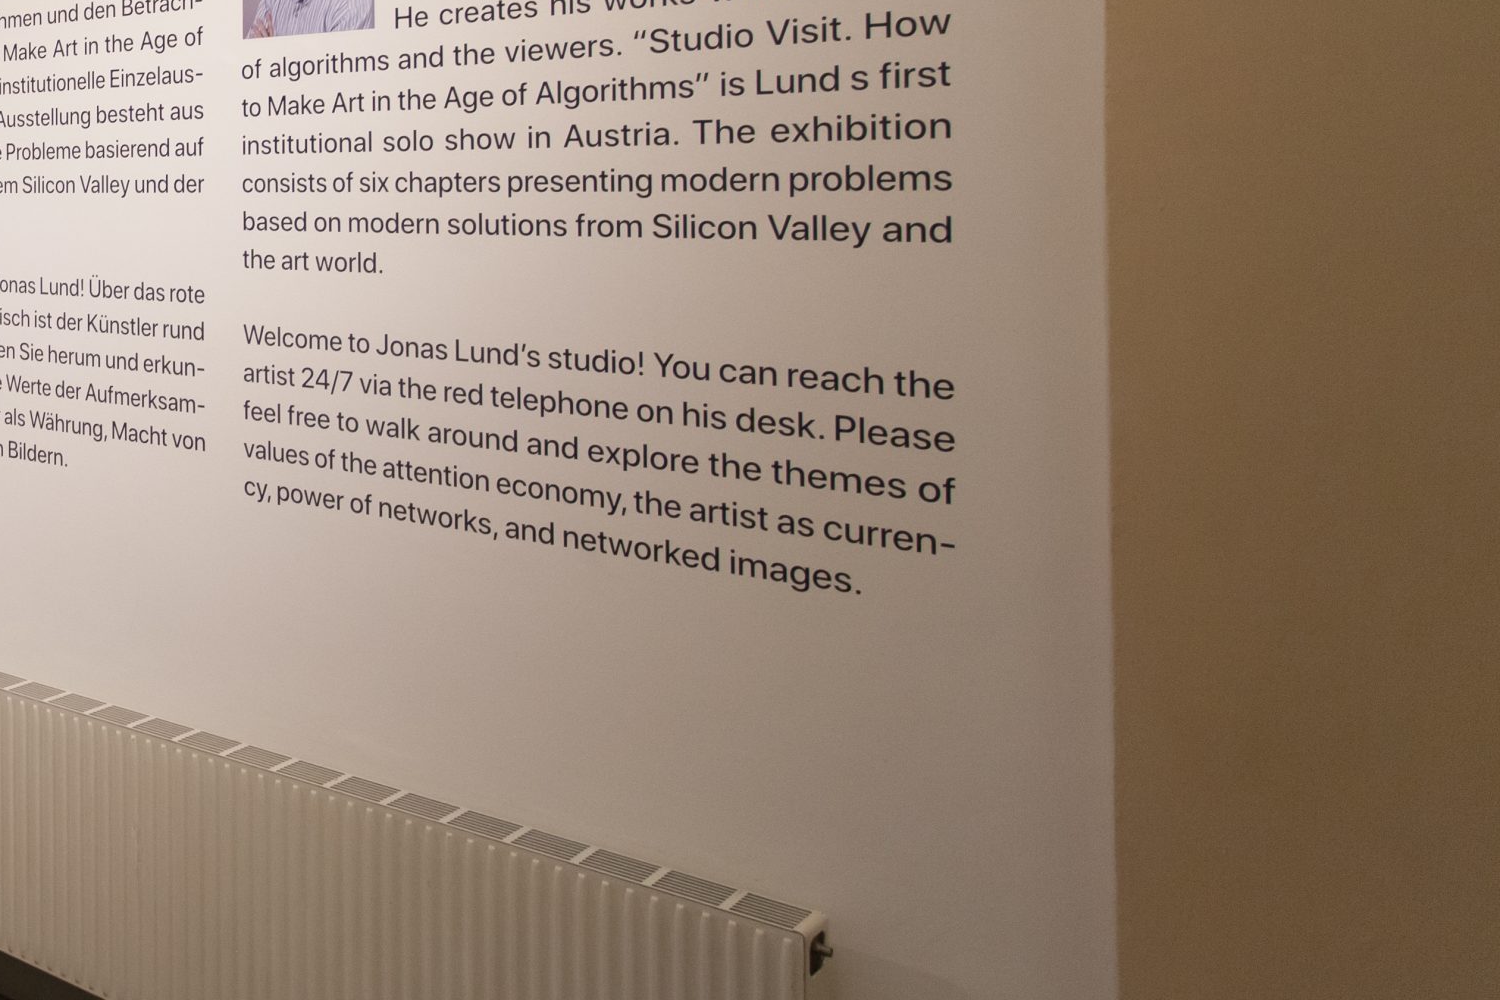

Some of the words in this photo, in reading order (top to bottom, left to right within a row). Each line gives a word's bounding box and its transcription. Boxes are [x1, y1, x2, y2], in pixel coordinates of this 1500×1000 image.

[46, 2, 79, 25] und
[83, 0, 117, 22] den
[394, 5, 429, 30] He
[438, 0, 539, 26] creates
[241, 57, 263, 81] of
[268, 51, 390, 83] algorithms
[397, 44, 444, 71] and
[452, 42, 496, 67] the
[504, 38, 623, 64] viewers.
[765, 15, 852, 46] Visit.
[864, 10, 952, 40] How
[109, 65, 204, 89] Einzelaus-
[95, 101, 165, 125] besteht
[169, 104, 205, 122] aus
[5, 141, 82, 162] Probleme
[84, 136, 171, 160] basierend
[174, 135, 205, 158] auf
[241, 130, 373, 156] institutional
[382, 128, 435, 153] solo
[444, 127, 517, 152] show
[527, 124, 552, 150] in
[563, 120, 680, 149] Austria.
[691, 118, 756, 146] The
[770, 111, 952, 144] exhibition
[242, 210, 308, 233] based
[313, 215, 342, 233] on
[347, 211, 440, 235] modern
[447, 211, 568, 238] solutions
[574, 212, 643, 239] from
[651, 212, 758, 241] Silicon
[766, 213, 873, 250] Valley
[881, 214, 953, 244] and
[33, 309, 53, 330] ist
[55, 311, 84, 332] der
[86, 312, 160, 338] Künstler
[162, 320, 205, 342] rund
[243, 363, 296, 388] artist
[300, 366, 354, 396] 24/7
[358, 372, 392, 397] via
[397, 376, 438, 402] the
[443, 382, 484, 407] red
[489, 385, 630, 421] telephone
[636, 403, 674, 426] on
[682, 400, 728, 431] his
[735, 406, 826, 441] desk.
[834, 413, 956, 453] Please
[3, 407, 27, 428] als
[28, 409, 108, 443] Währung,
[111, 420, 169, 448] Macht
[171, 432, 207, 453] von
[7, 439, 69, 468] Bildern.
[243, 480, 272, 504] cy,
[276, 484, 345, 511] power
[349, 493, 373, 516] of
[378, 500, 499, 542] networks,
[504, 520, 555, 547] and
[562, 529, 721, 573] networked
[729, 548, 862, 596] images.
